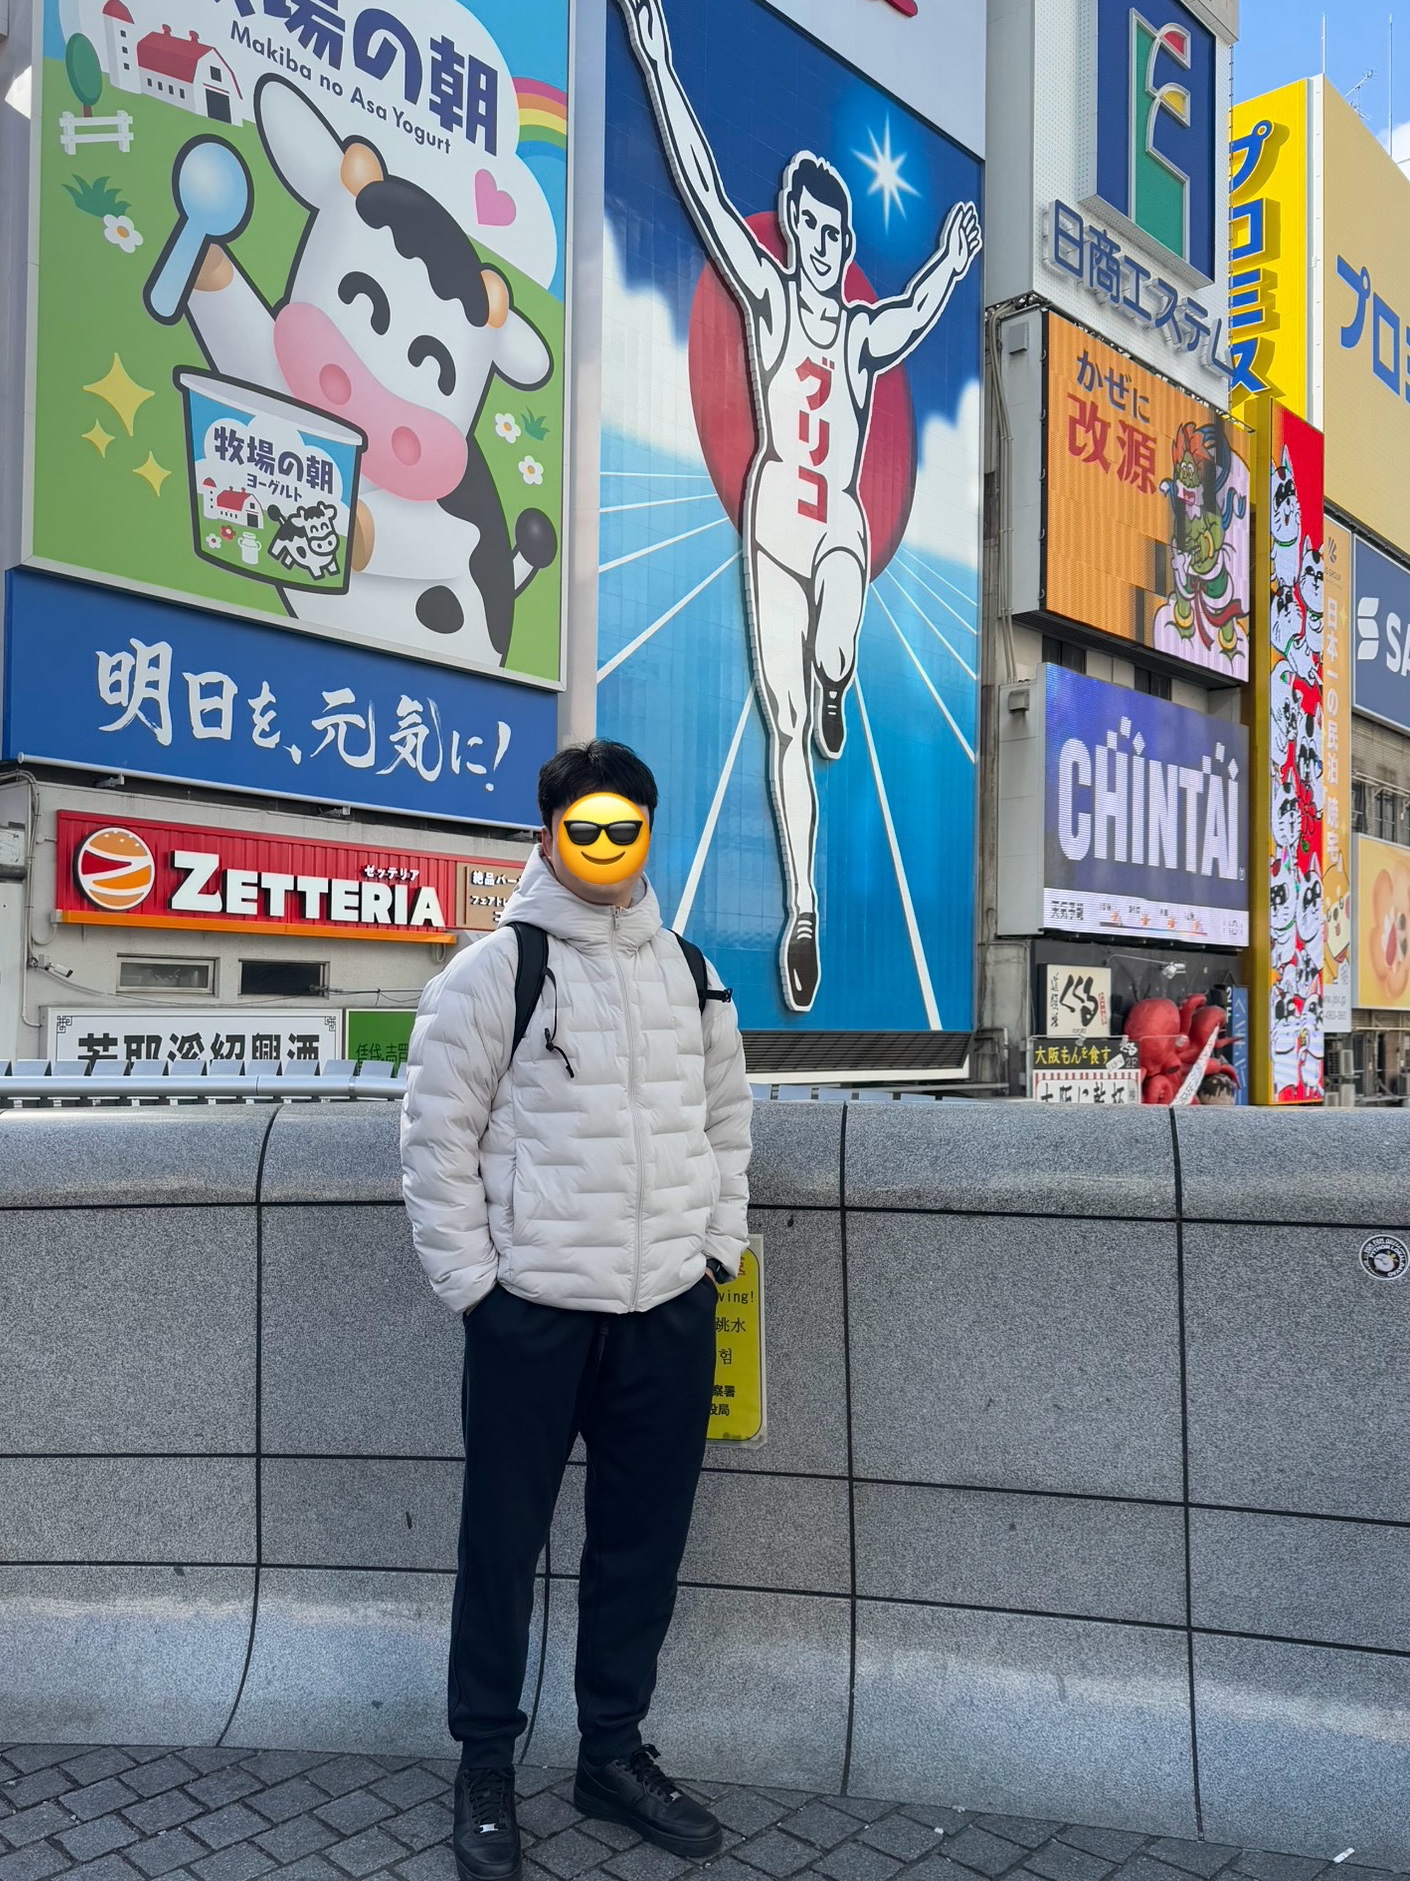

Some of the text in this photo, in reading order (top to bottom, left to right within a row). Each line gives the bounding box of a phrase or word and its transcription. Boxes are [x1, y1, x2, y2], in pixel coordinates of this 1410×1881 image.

[214, 0, 498, 157] の朝
[230, 20, 452, 155] Makiba no Asa Yogurt
[1229, 119, 1273, 393] プロミス
[1336, 255, 1410, 405] プロ
[1076, 348, 1150, 424] かぜに
[214, 425, 334, 495] 牧場の朝
[794, 356, 835, 524] グリコ
[1067, 391, 1157, 495] 改源
[247, 472, 303, 503] ヨーグルト
[1057, 718, 1239, 881] CHINTAI
[171, 849, 446, 928] ZETTERIA
[364, 864, 420, 882] ゼッテリア
[472, 870, 522, 886] 絶品バー
[1059, 974, 1098, 1027] くくる
[1035, 1045, 1111, 1065] 大阪もんを食す
